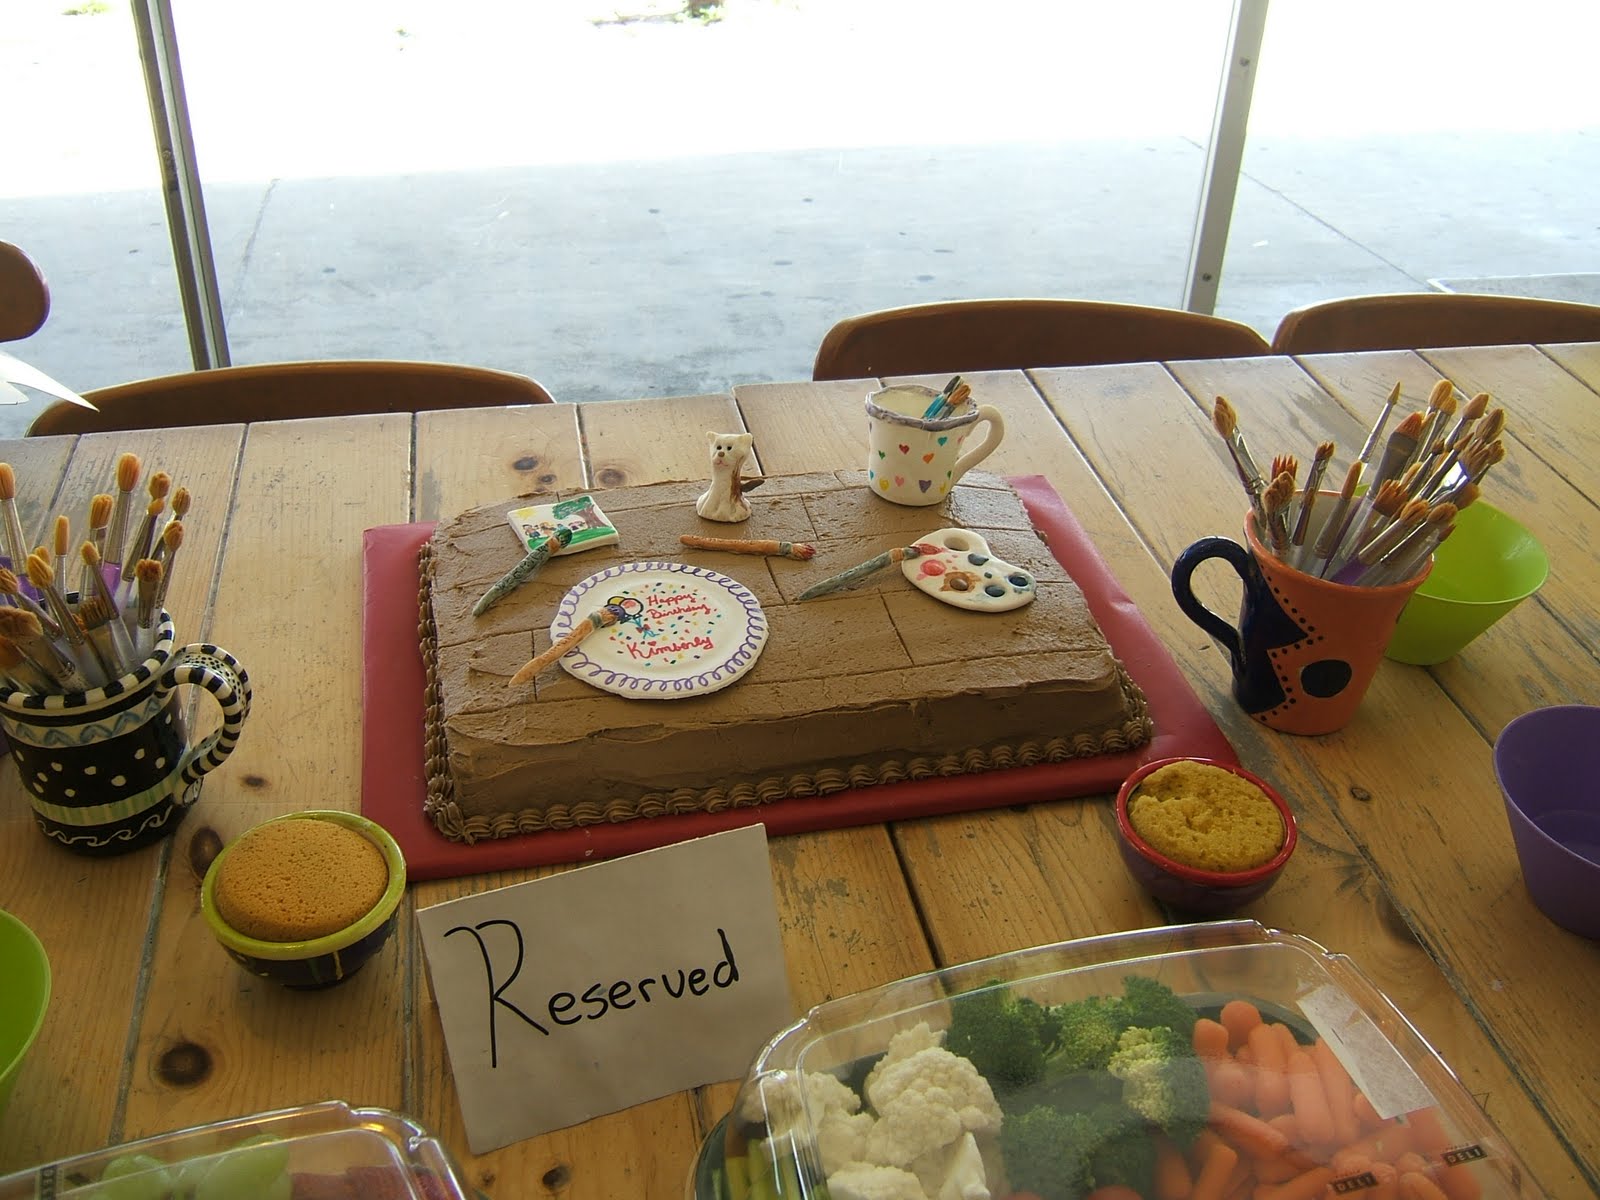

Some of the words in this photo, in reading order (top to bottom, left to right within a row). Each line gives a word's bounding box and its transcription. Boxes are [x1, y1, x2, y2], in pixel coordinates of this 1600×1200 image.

[646, 594, 696, 606] Happy
[626, 636, 714, 659] Kimberly
[443, 919, 740, 1068] Reserved
[1446, 1147, 1481, 1163] DELI
[1336, 1175, 1372, 1192] DELI
